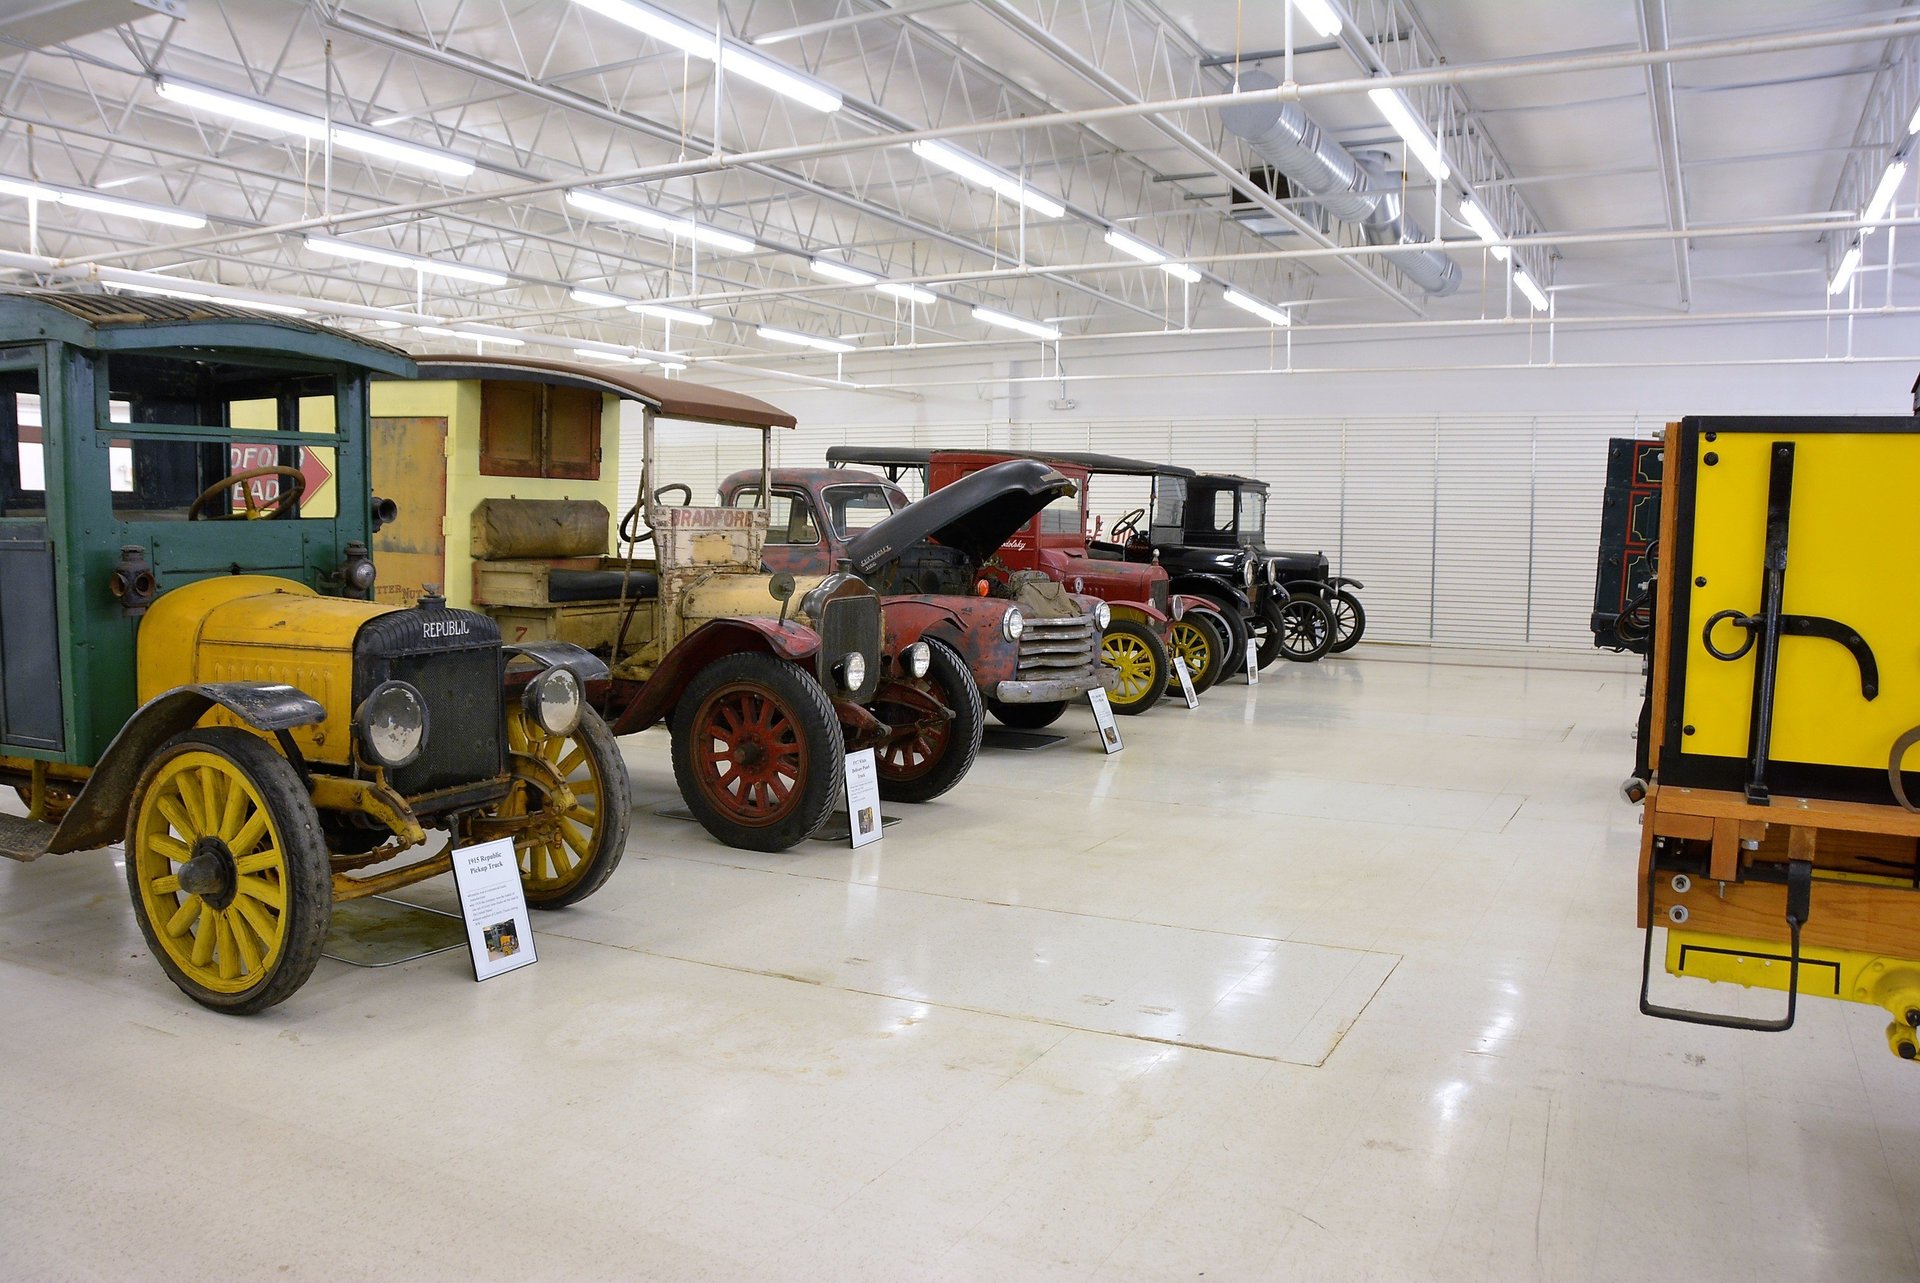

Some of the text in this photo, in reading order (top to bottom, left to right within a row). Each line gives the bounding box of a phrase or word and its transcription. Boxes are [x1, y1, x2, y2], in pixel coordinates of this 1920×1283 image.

[231, 447, 305, 469] DFOD
[233, 480, 279, 501] EAD
[672, 509, 753, 528] BRADFORD
[423, 620, 470, 638] REPUBLIC
[515, 626, 528, 642] 7
[467, 852, 502, 865] 1915 Republic
[470, 861, 503, 875] Pickup Truck
